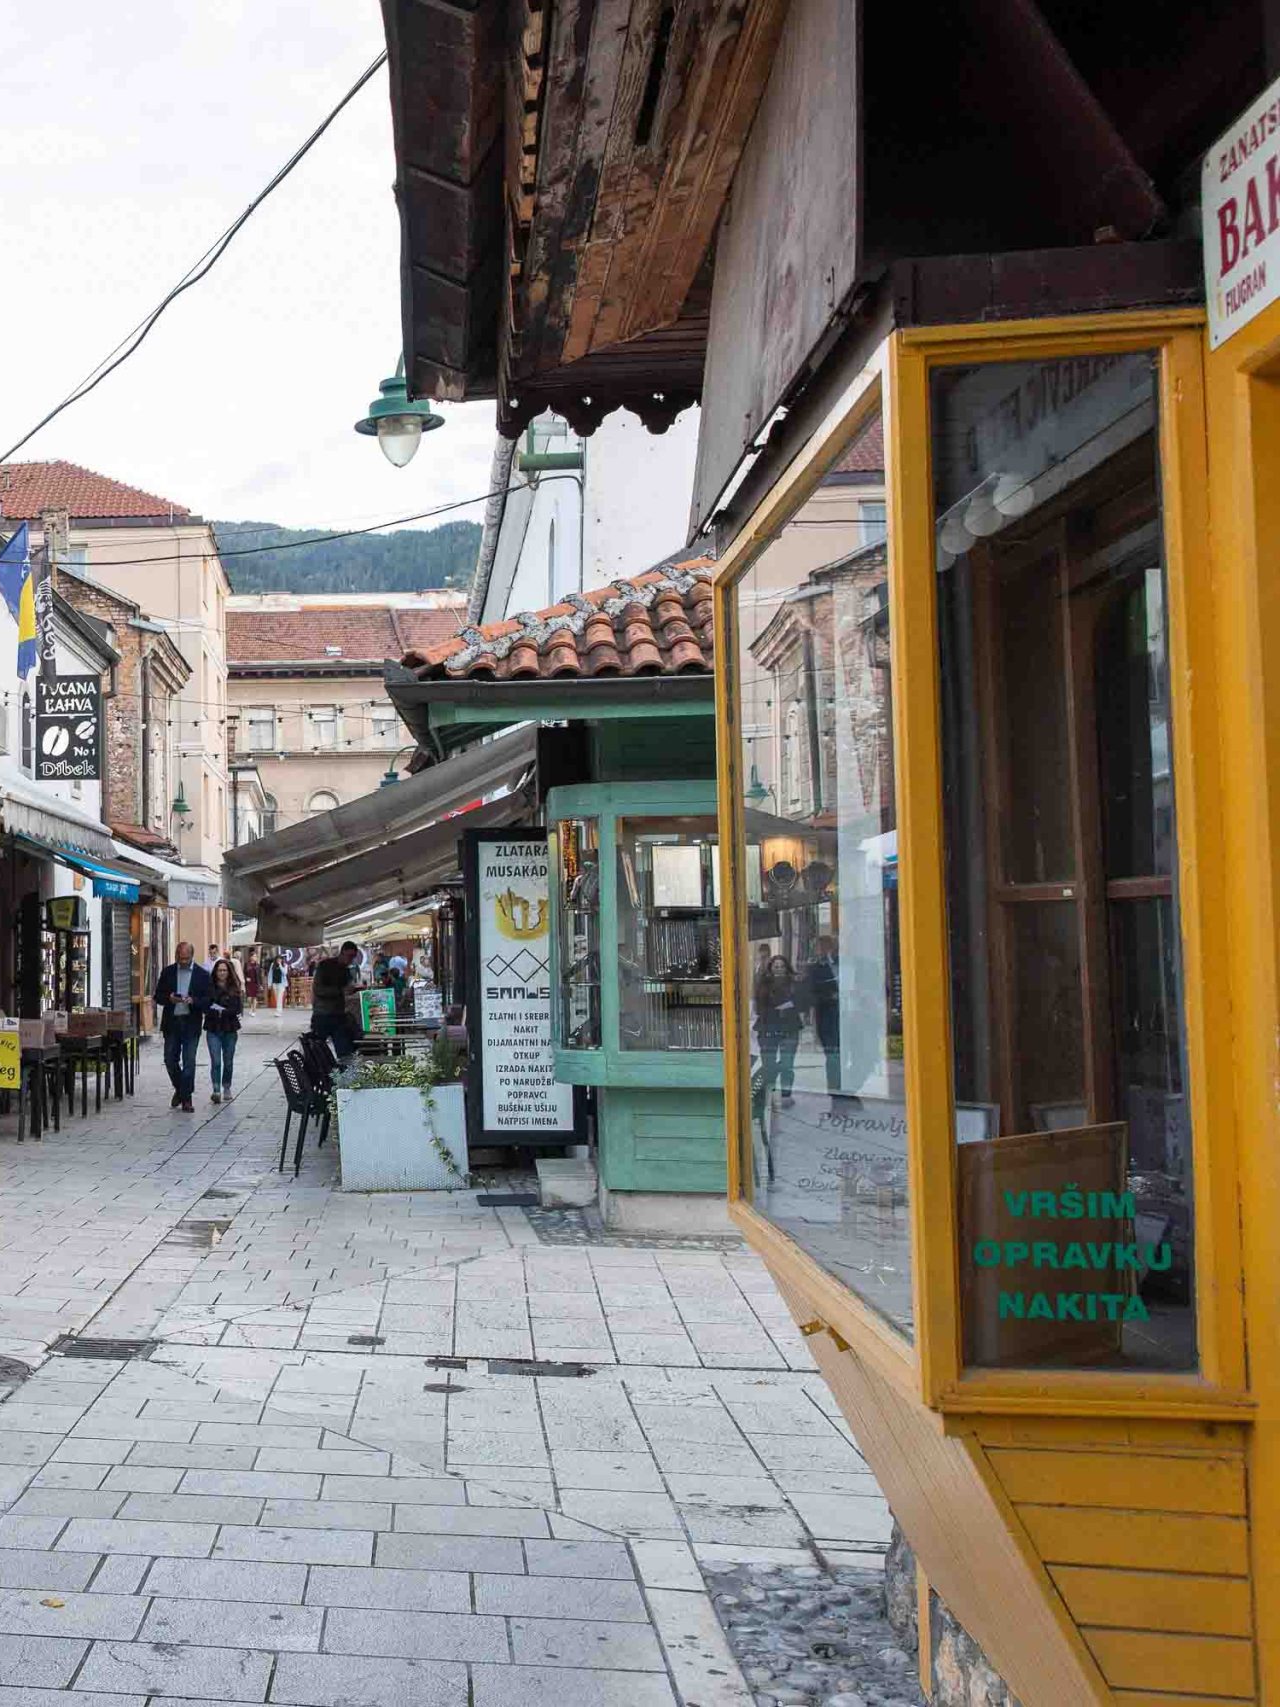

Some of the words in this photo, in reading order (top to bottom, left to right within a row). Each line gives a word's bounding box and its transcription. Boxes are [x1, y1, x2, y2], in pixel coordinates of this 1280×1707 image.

[1220, 98, 1280, 183] ZANATS
[1225, 261, 1267, 318] FILIGRAN
[73, 746, 89, 757] No
[39, 759, 96, 776] Dibek
[496, 846, 549, 857] ZLATARA
[486, 865, 548, 878] MUSAKAD
[489, 1012, 517, 1021] ZLATNI
[524, 1012, 550, 1021] SREBR
[513, 1025, 539, 1034] NAKIT
[487, 1039, 538, 1047] DIJAMANTNI
[513, 1051, 540, 1060] OTKUP
[495, 1065, 526, 1073] IZRADA
[528, 1065, 553, 1073] NAKIT
[499, 1078, 511, 1086] PO
[513, 1076, 555, 1086] NARUDŽBI
[507, 1091, 547, 1099] POPRAVCI
[498, 1102, 532, 1112] BUŠENJE
[534, 1102, 558, 1112] UŠIJU
[497, 1117, 529, 1126] NATPISI
[532, 1117, 559, 1126] IMENA
[1003, 1182, 1136, 1219] VRŠIM
[973, 1240, 1172, 1271] OPRAVKU
[999, 1292, 1151, 1322] NAKITA
